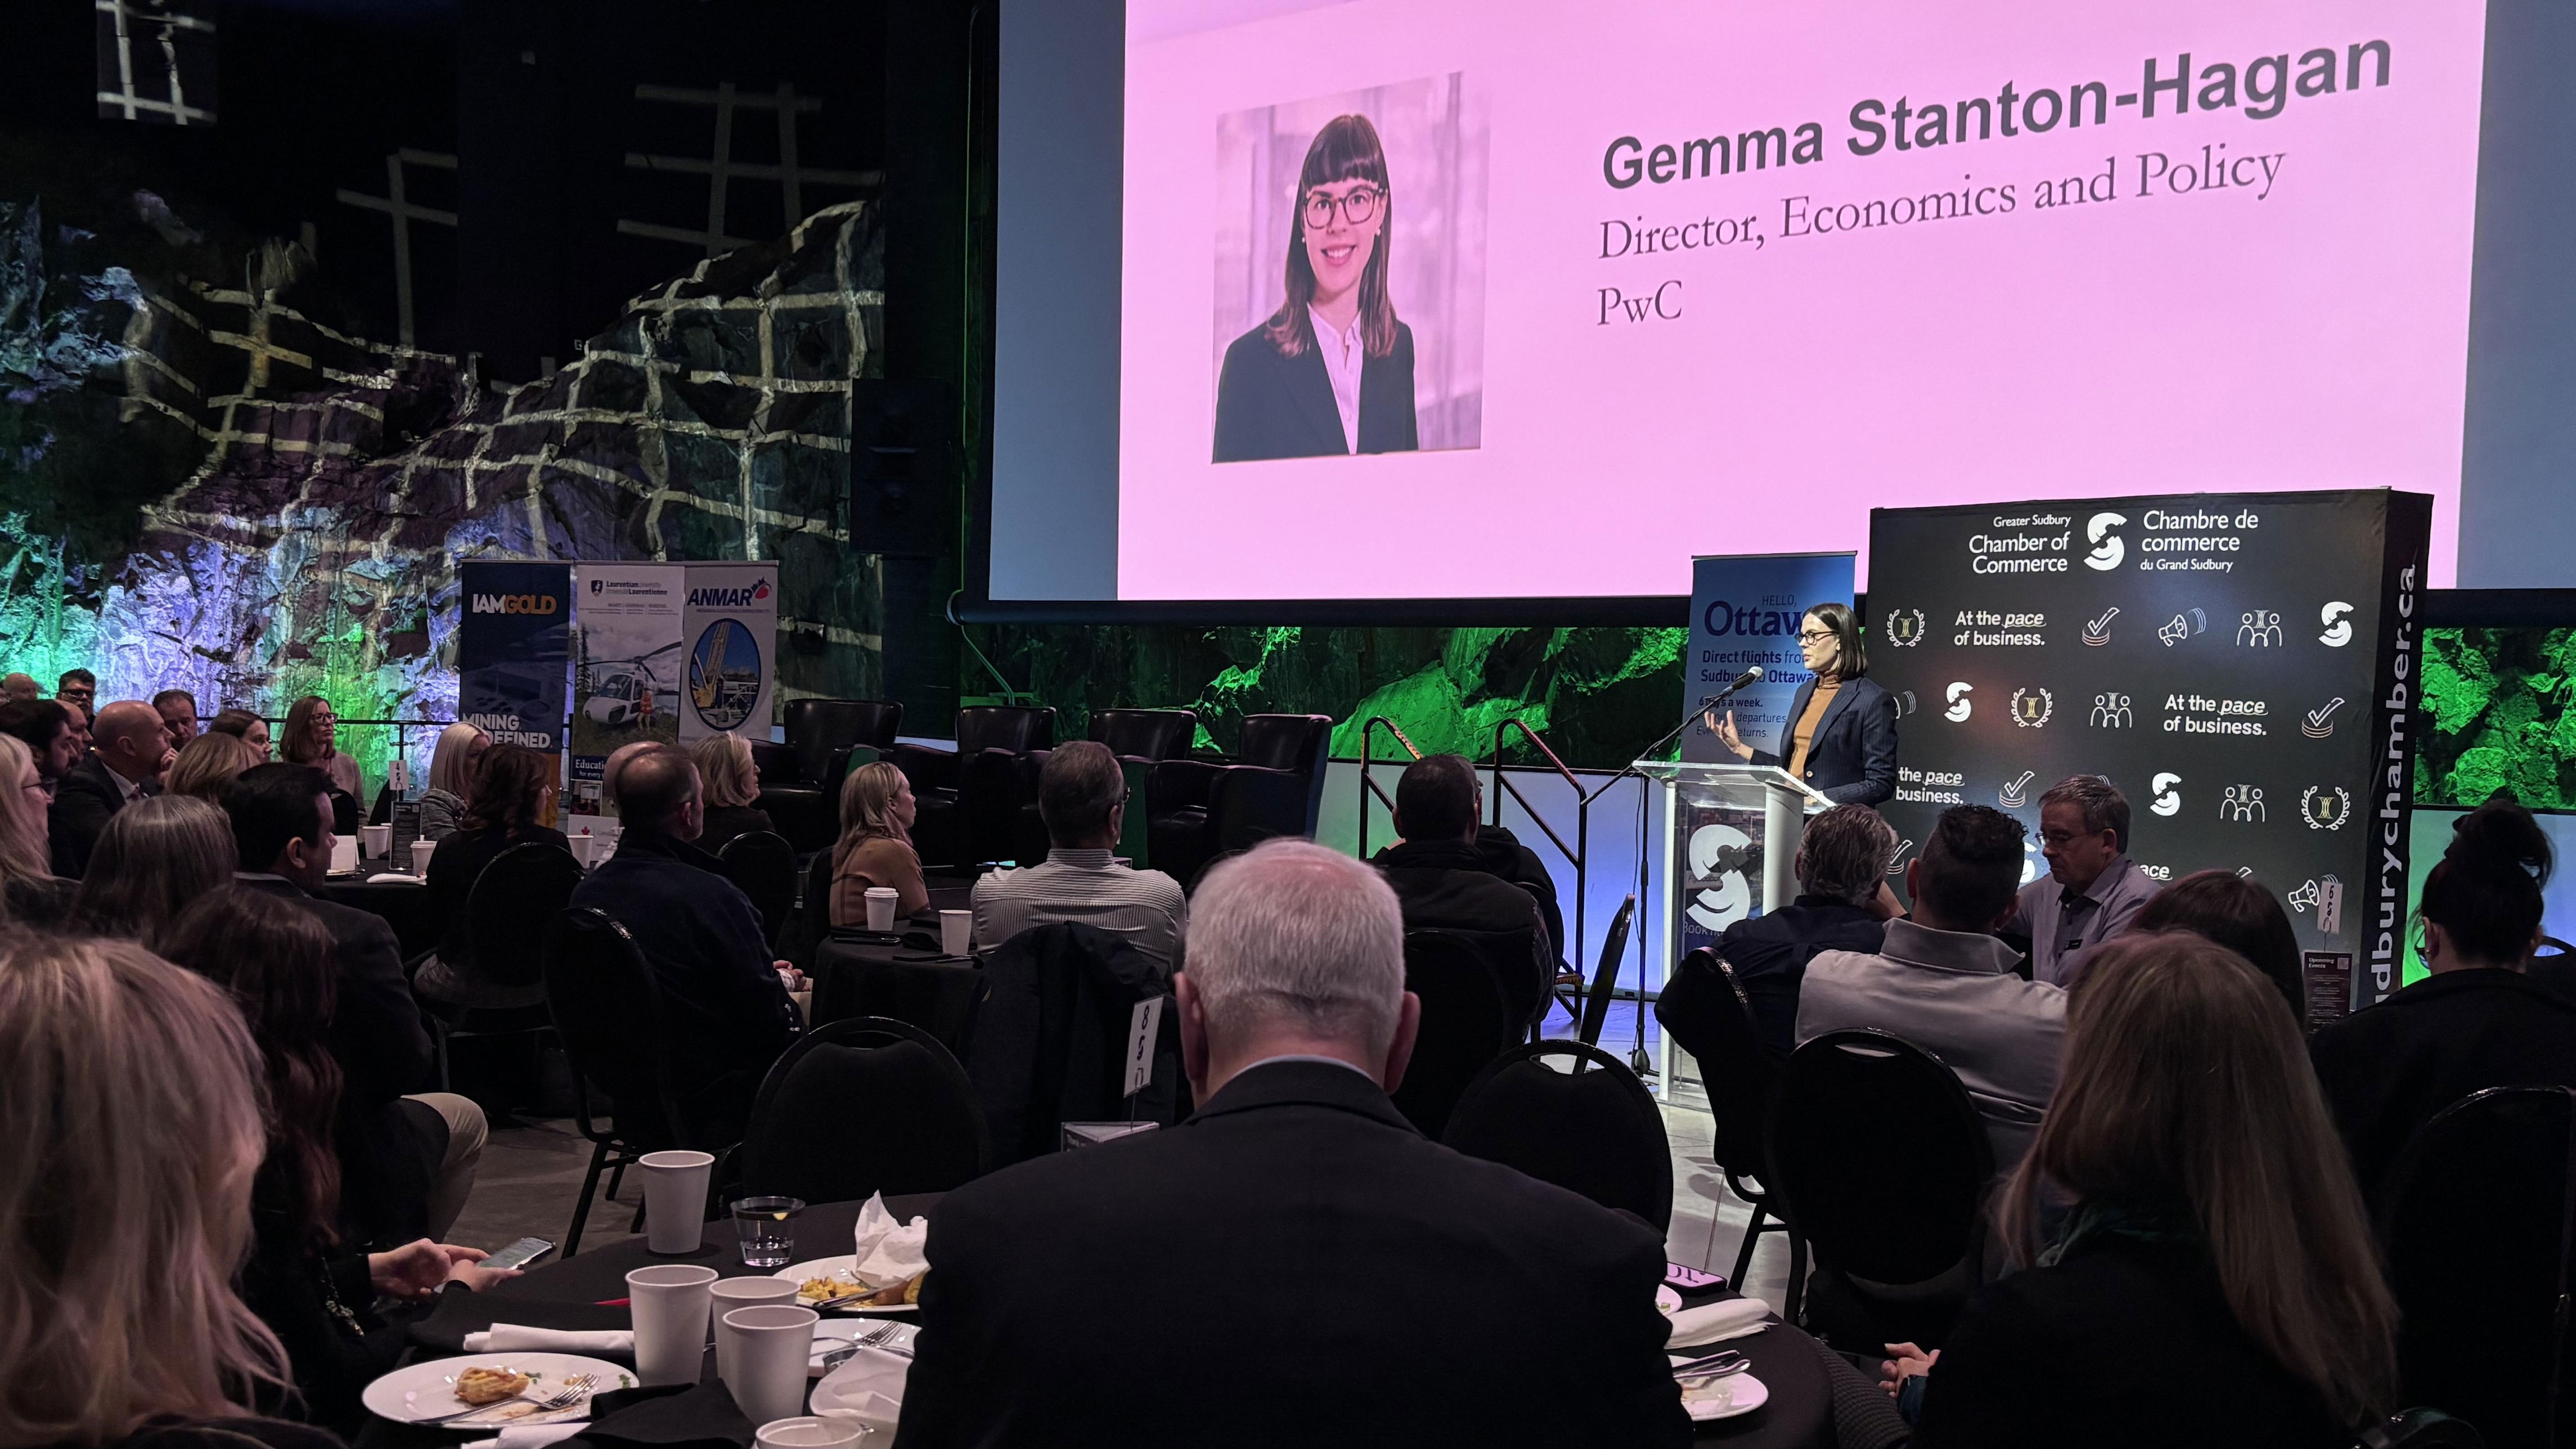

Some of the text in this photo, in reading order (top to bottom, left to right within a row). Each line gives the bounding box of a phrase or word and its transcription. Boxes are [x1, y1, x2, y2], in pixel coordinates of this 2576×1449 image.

[1603, 39, 2390, 189] Gemma Stanton-Hagan
[1598, 143, 2287, 259] Director, Economics and Policy
[1598, 280, 1683, 326] PwC
[1993, 514, 2071, 528] Greater Sudbury
[2143, 508, 2259, 530] Chambre de
[1969, 531, 2071, 554] Chamber of
[2142, 537, 2240, 551] commerce
[1972, 555, 2068, 574] Commerce
[2140, 559, 2233, 573] du Grand Sudbury
[473, 593, 557, 615] IAMGOLD
[687, 588, 753, 606] ANMAR
[1762, 595, 1797, 607] HELLO,
[1705, 600, 1802, 636] Ottaw
[1955, 610, 2044, 628] At the pace
[1954, 631, 2045, 646] of business.
[1703, 650, 1804, 667] Direct flights fro
[1701, 669, 1745, 682] Sudbu
[1736, 698, 1763, 707] week.
[2164, 694, 2265, 716] At the pace
[1737, 713, 1787, 724] departures
[2164, 716, 2267, 736] of business.
[1738, 729, 1769, 737] eturns.
[1898, 767, 1963, 786] the pace
[1896, 786, 1964, 804] business.
[2140, 864, 2170, 878] ace
[2328, 885, 2334, 899] 6
[1141, 1005, 1150, 1030] 8
